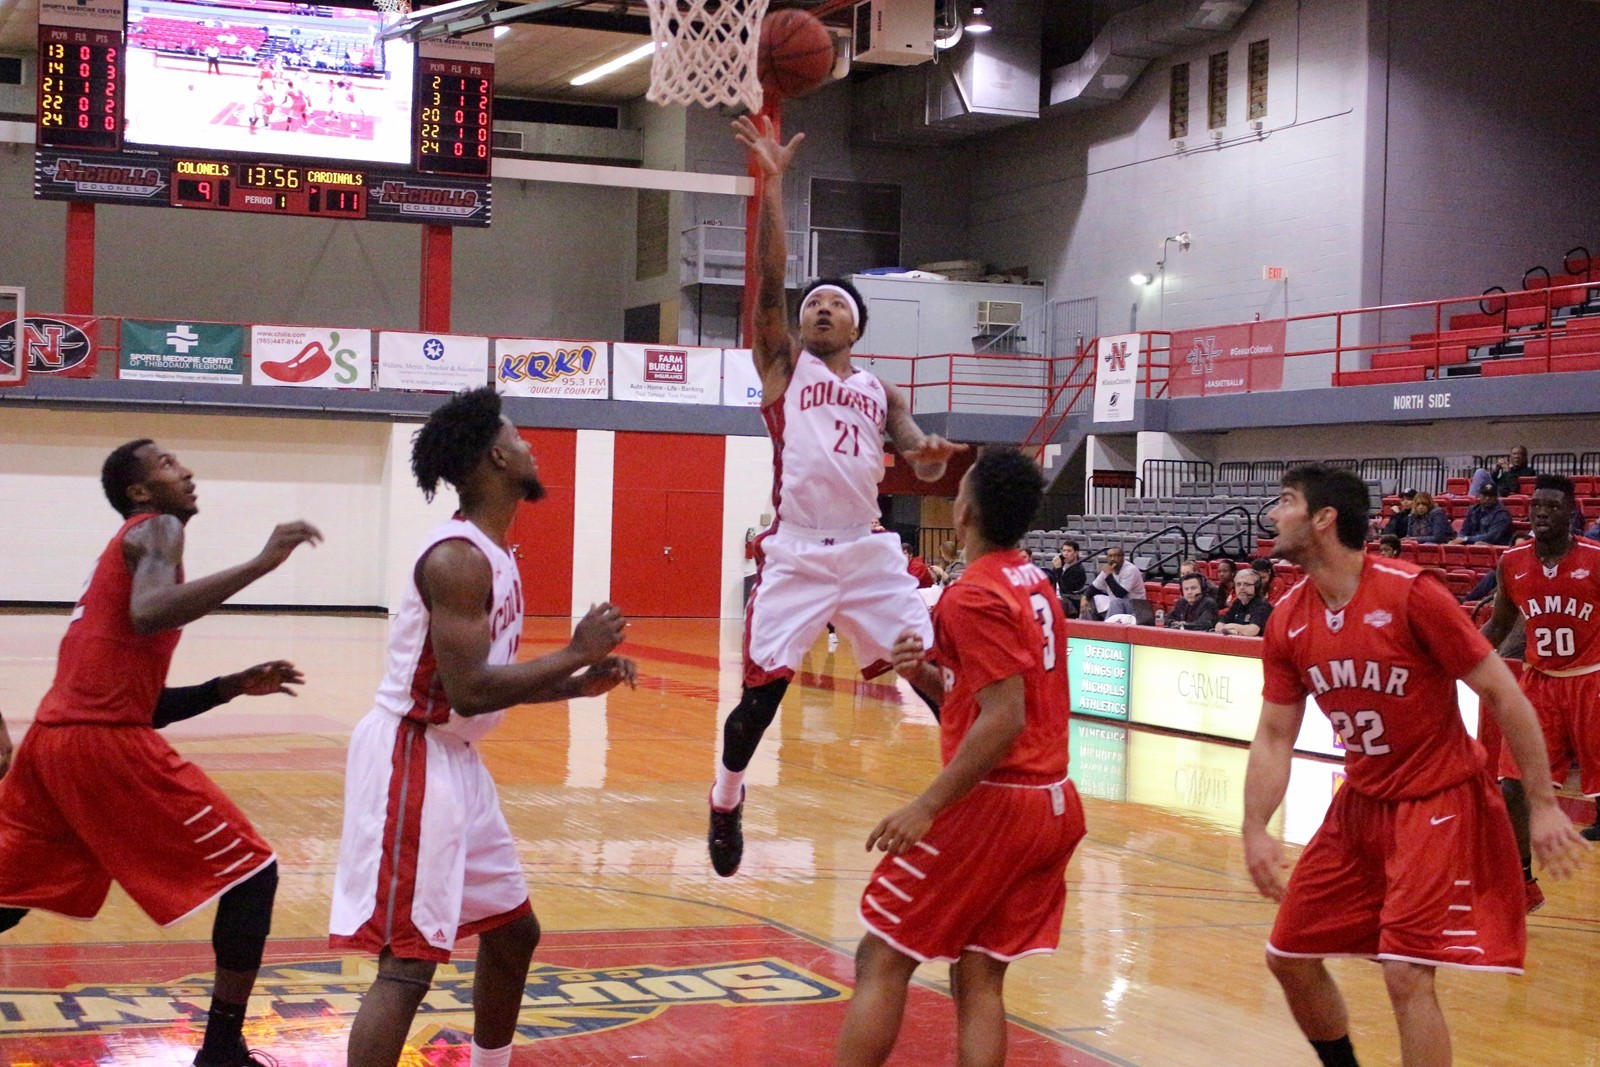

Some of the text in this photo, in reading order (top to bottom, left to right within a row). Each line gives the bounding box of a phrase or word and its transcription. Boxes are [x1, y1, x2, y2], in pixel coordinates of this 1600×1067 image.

[75, 33, 87, 42] FLS
[96, 34, 108, 43] PTS
[48, 44, 116, 62] 13 0 2
[48, 62, 116, 79] 14 0 3
[430, 64, 481, 75] PLYR FLS PTS
[43, 78, 64, 91] 21
[105, 82, 115, 96] 2
[432, 76, 440, 89] 2
[480, 80, 488, 93] 2
[42, 95, 115, 113] 22 0 2
[433, 92, 440, 106] 3
[480, 96, 488, 109] 2
[42, 112, 114, 130] 24 0 0
[422, 107, 487, 125] 20 0 0
[422, 124, 440, 138] 22
[478, 128, 487, 142] 0
[422, 140, 486, 157] 24 0 0
[56, 159, 159, 187] NICHOLLS
[178, 161, 229, 176] COLONELS
[248, 168, 298, 188] 13:56
[308, 171, 362, 185] CARDINALS
[82, 183, 148, 193] COLONELS
[198, 182, 210, 200] 9
[382, 181, 478, 207] NICHOLLS
[245, 195, 272, 205] PERIOD
[281, 196, 286, 207] 1
[340, 193, 358, 209] 11
[406, 204, 466, 213] COLONELS
[1269, 268, 1281, 279] EXIT
[659, 354, 683, 363] FARM
[1110, 342, 1127, 372] N
[1230, 344, 1273, 356] #GeauxColonels
[499, 347, 596, 382] KQKI
[648, 363, 683, 372] BUREAU
[562, 378, 585, 386] 95.3
[1393, 393, 1451, 409] NORTH SIDE
[833, 420, 859, 457] 21
[1535, 627, 1575, 656] 20
[1084, 644, 1125, 661] OFFICIAL
[1082, 661, 1126, 679] WINGS OF
[1307, 659, 1409, 697] AMAR
[1082, 678, 1125, 697] NICHOLLS
[1178, 670, 1233, 704] CARMEL
[1079, 696, 1127, 715] ATHLETICS
[1330, 710, 1392, 756] 22
